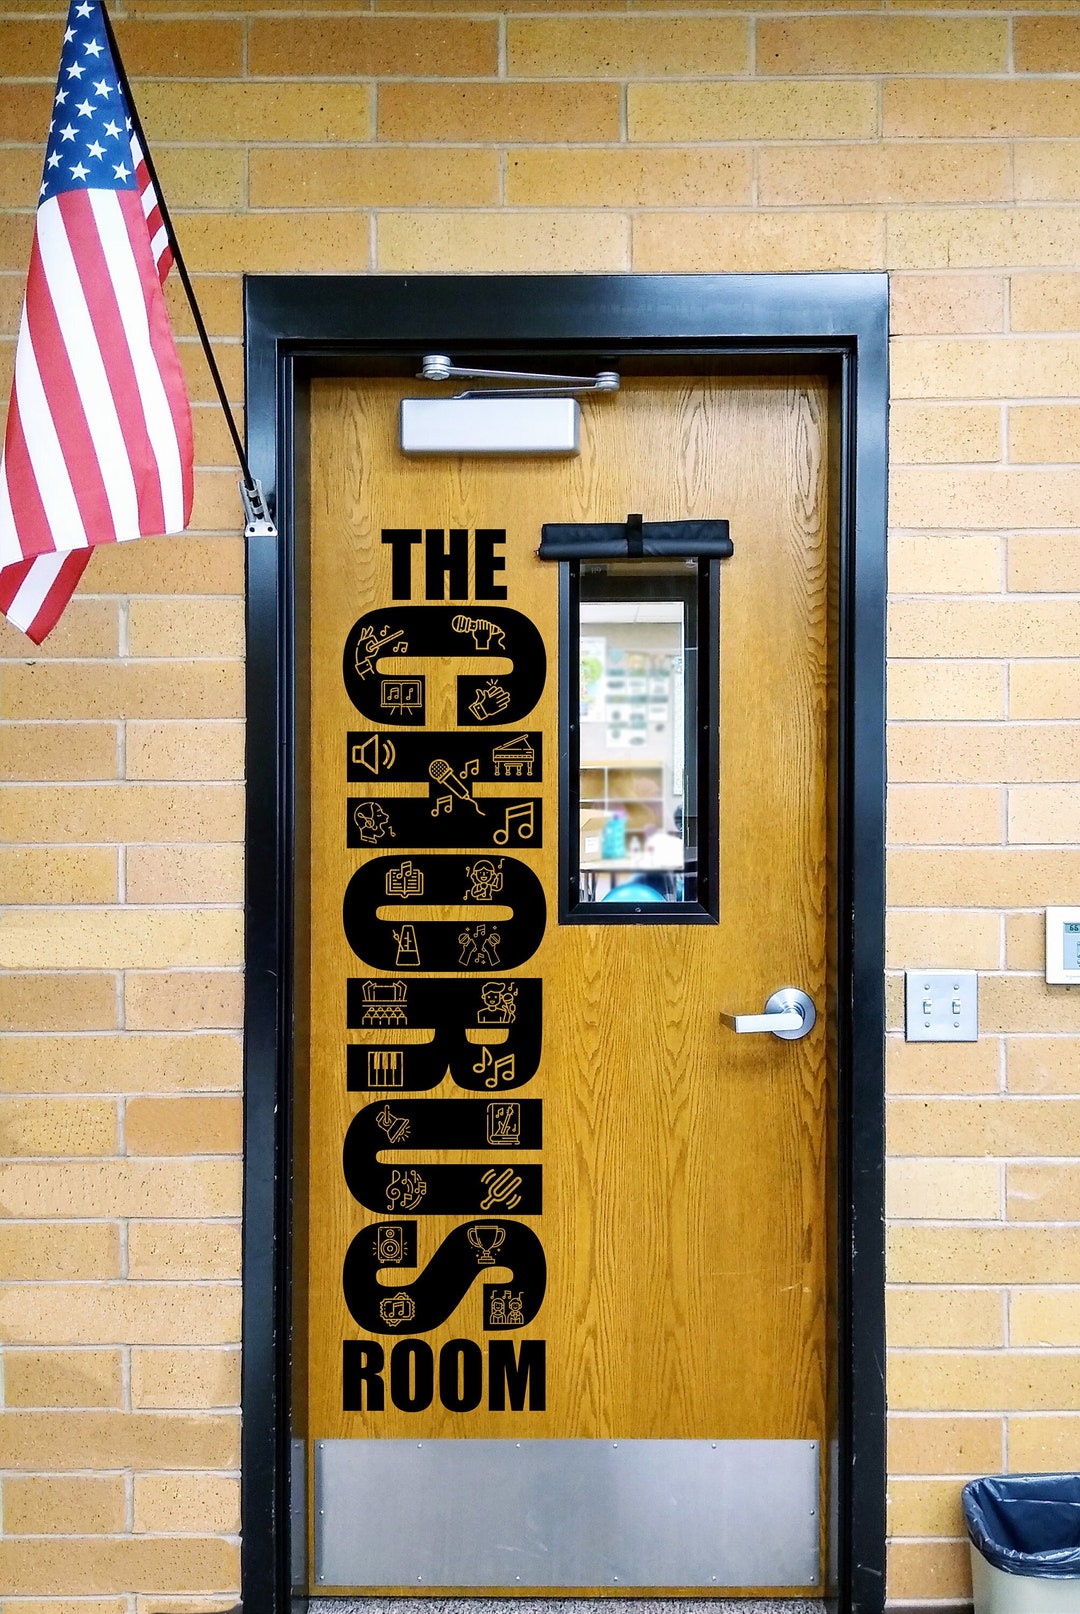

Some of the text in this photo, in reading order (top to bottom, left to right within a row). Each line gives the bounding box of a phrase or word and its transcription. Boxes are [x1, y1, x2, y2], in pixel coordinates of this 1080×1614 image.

[381, 529, 508, 600] THE
[342, 605, 547, 1335] CHORUS
[342, 1338, 546, 1412] ROOM
